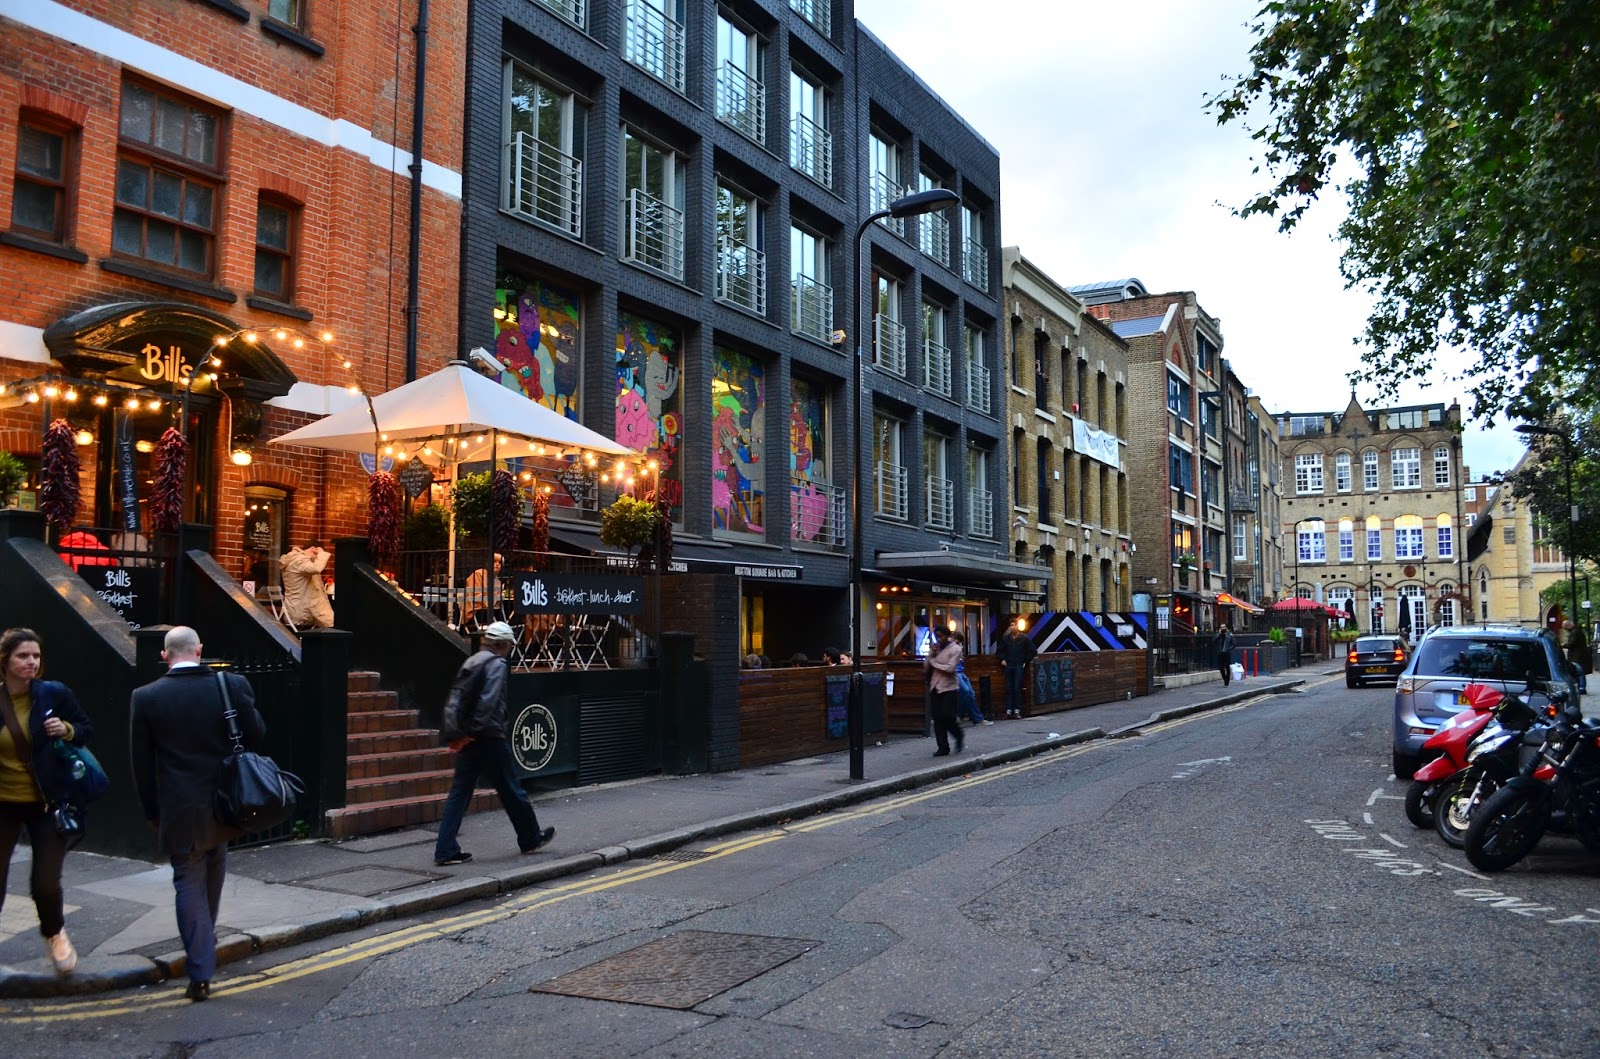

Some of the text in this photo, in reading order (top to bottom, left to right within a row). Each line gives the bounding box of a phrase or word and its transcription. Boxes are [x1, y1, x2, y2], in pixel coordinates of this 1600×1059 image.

[140, 343, 193, 386] Bill's
[105, 569, 131, 587] Bill's
[521, 579, 548, 606] Bill's
[589, 588, 611, 605] lunch
[520, 723, 548, 751] Bill's
[1453, 888, 1600, 924] ONLY
